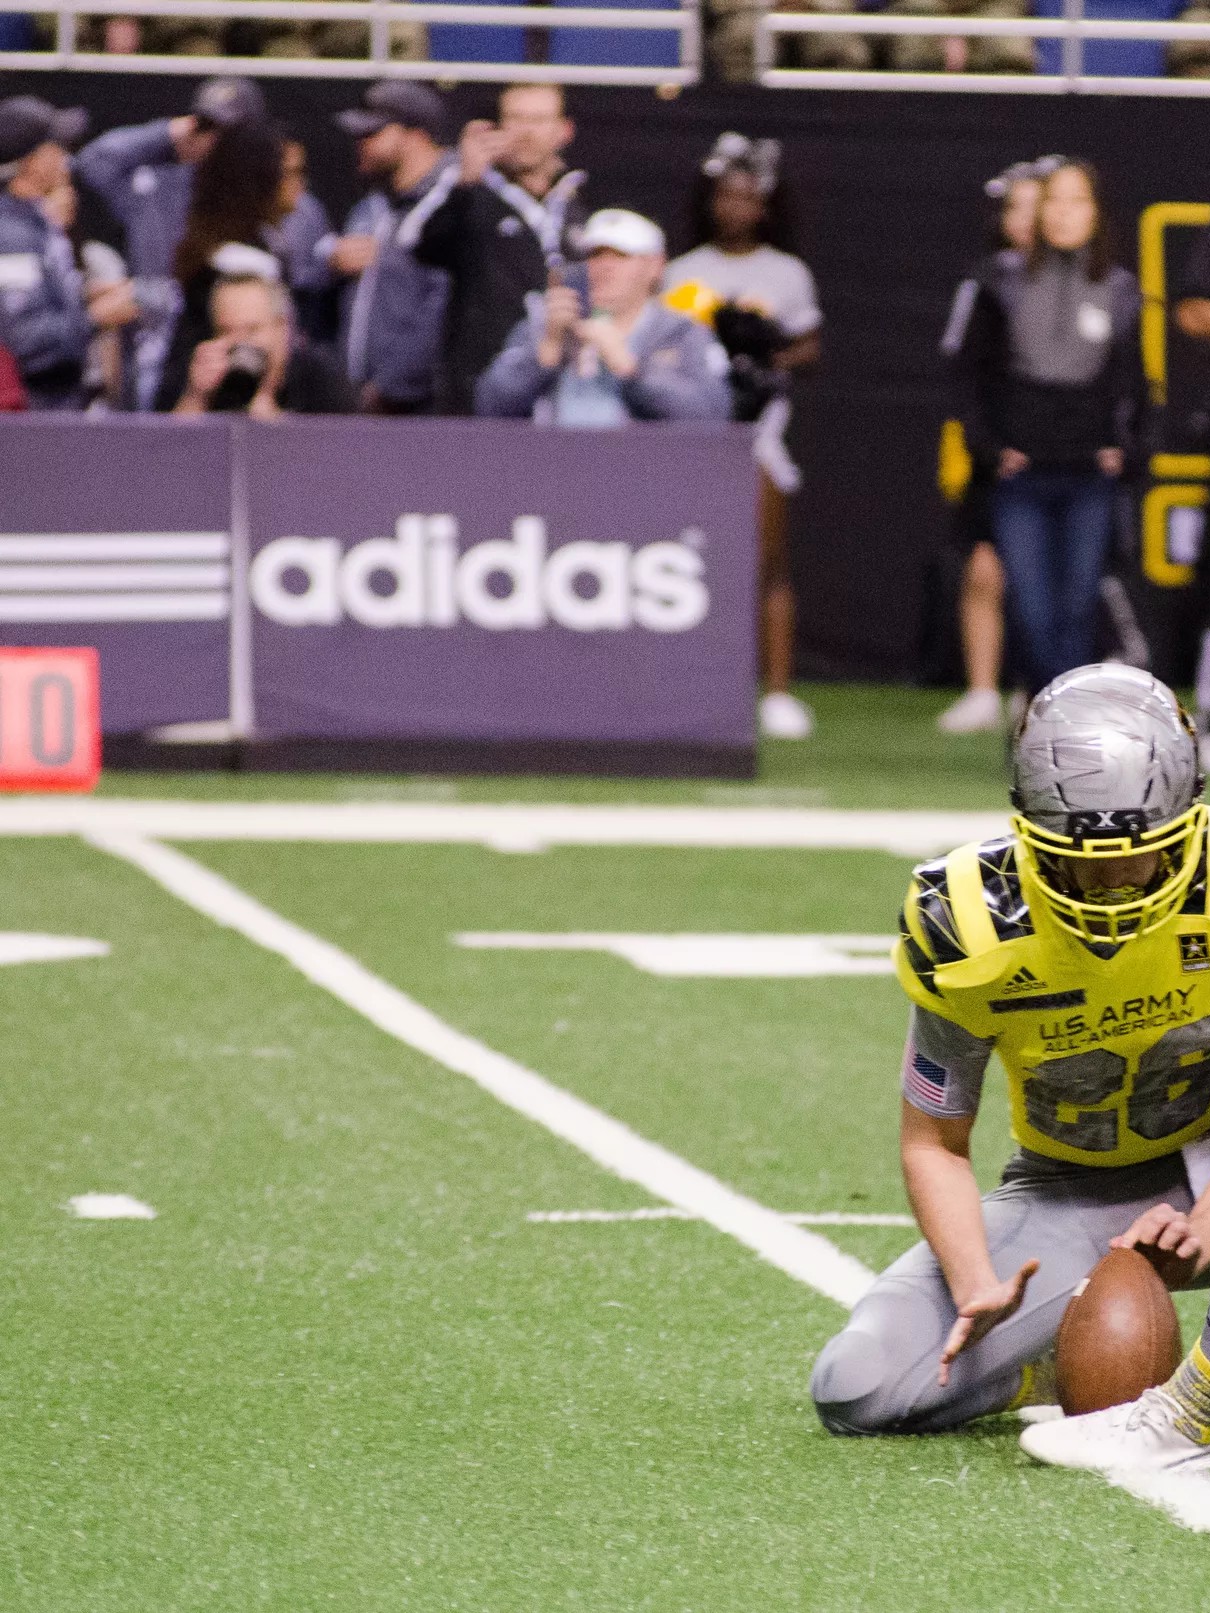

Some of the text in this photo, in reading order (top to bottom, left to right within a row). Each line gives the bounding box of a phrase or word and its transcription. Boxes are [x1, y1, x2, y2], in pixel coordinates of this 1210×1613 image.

[249, 513, 710, 632] adidas
[0, 672, 75, 768] 0
[1044, 1007, 1195, 1053] ALL-AMERICAN
[1098, 984, 1198, 1028] ARMY
